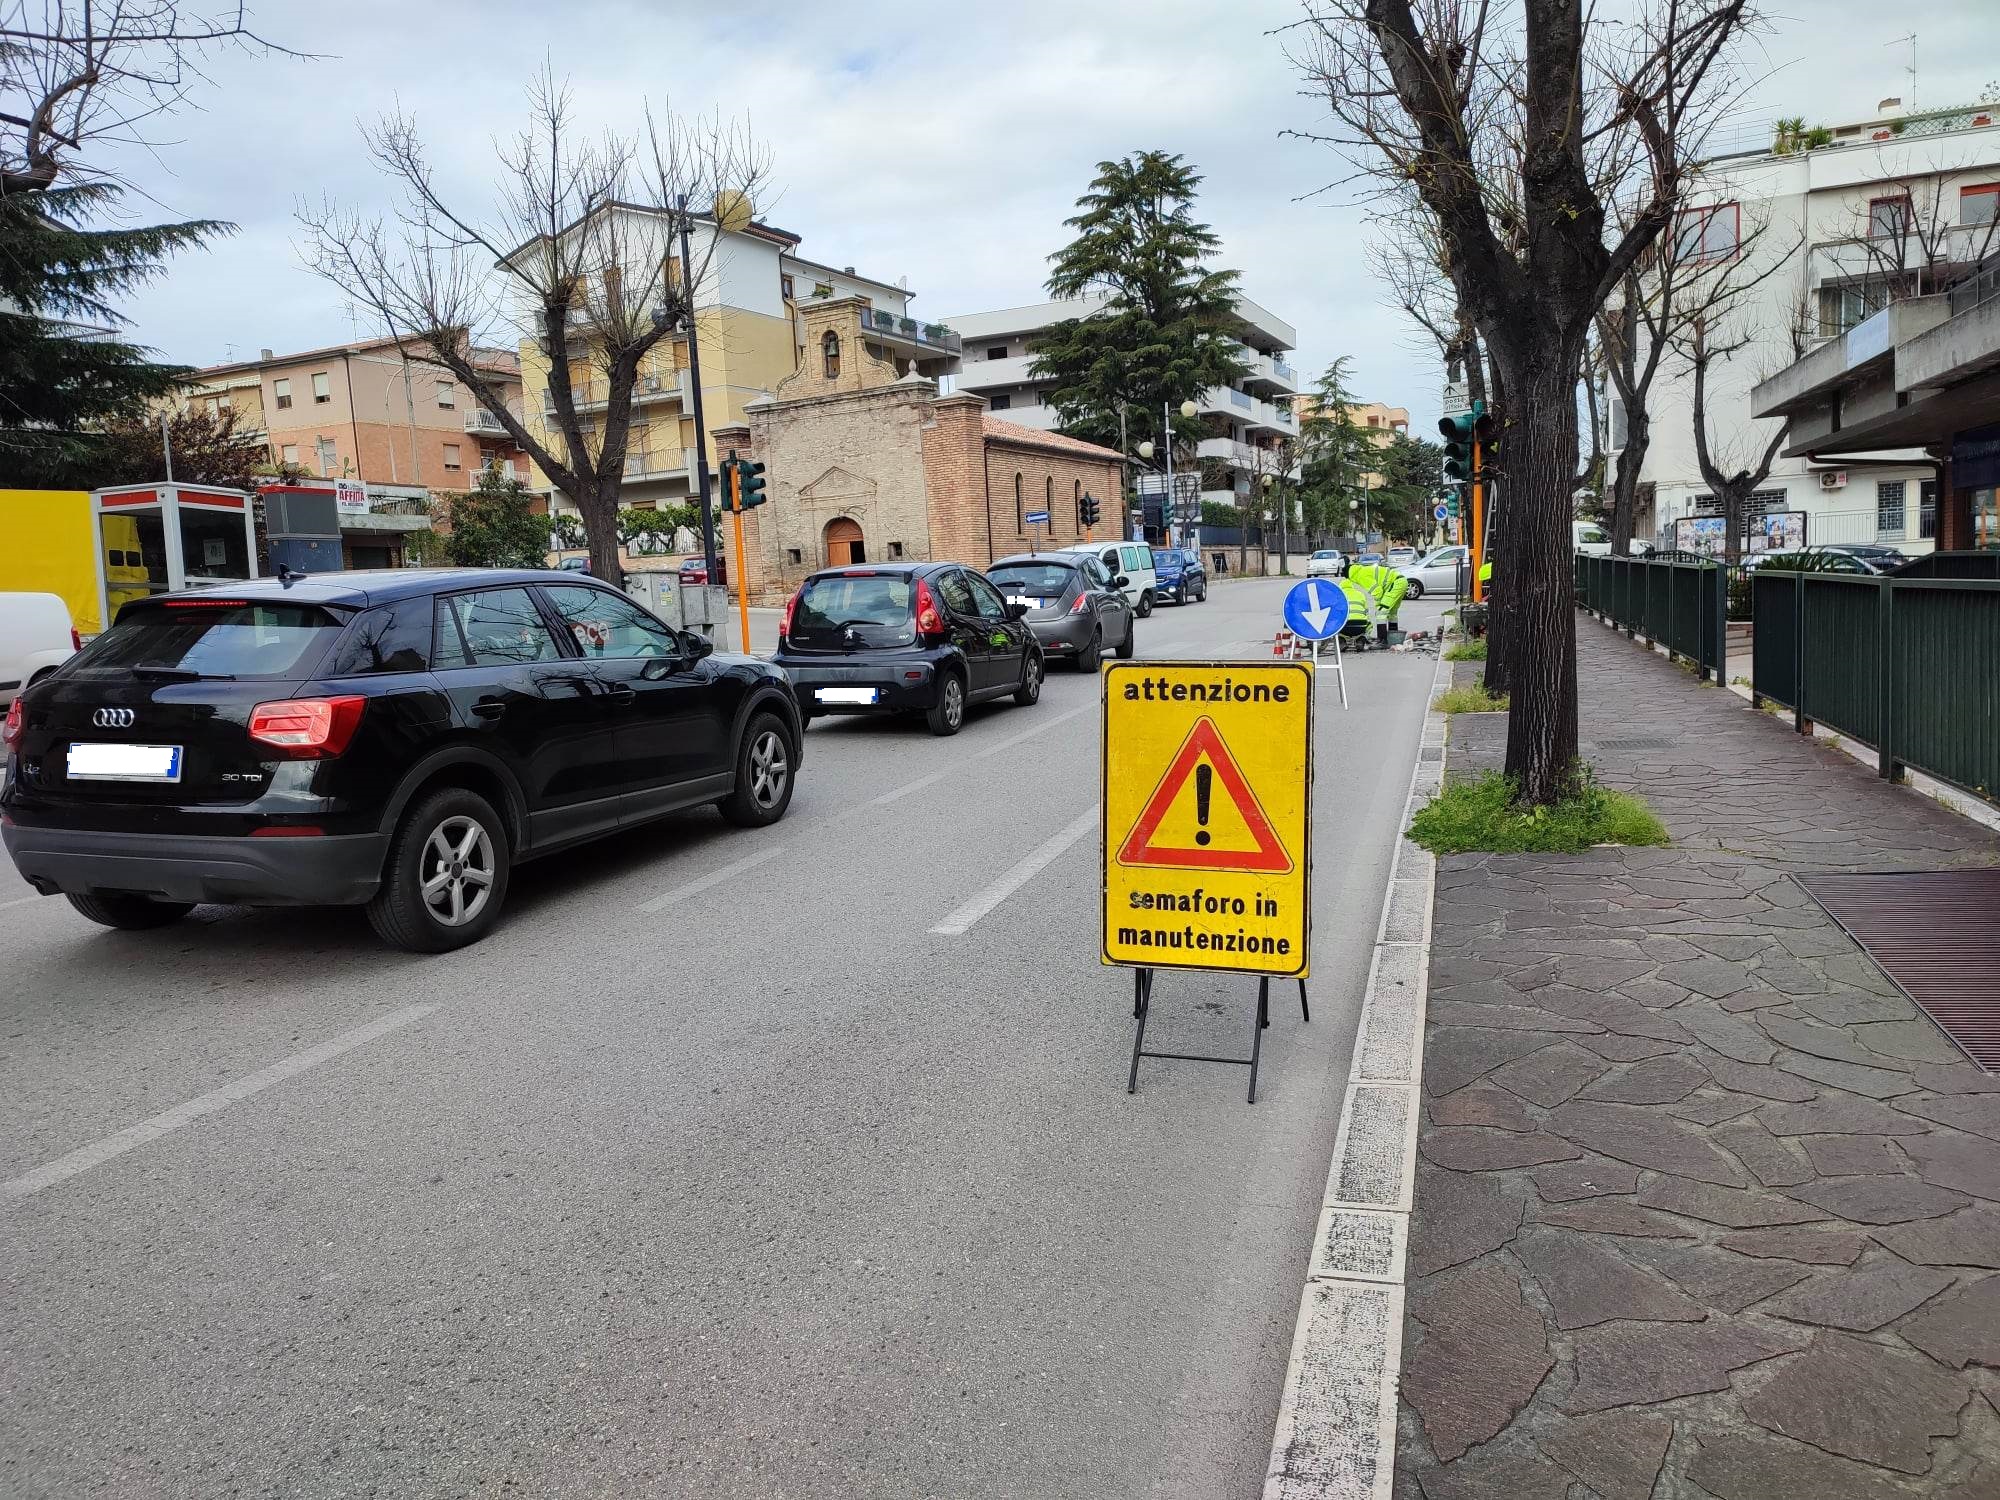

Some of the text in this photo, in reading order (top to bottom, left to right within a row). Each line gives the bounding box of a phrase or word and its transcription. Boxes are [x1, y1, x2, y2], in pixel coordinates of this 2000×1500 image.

[1124, 677, 1290, 703] attenzione
[221, 773, 263, 782] 30 TDI
[1129, 889, 1278, 917] semaforo in
[1118, 926, 1290, 955] manutenzione
